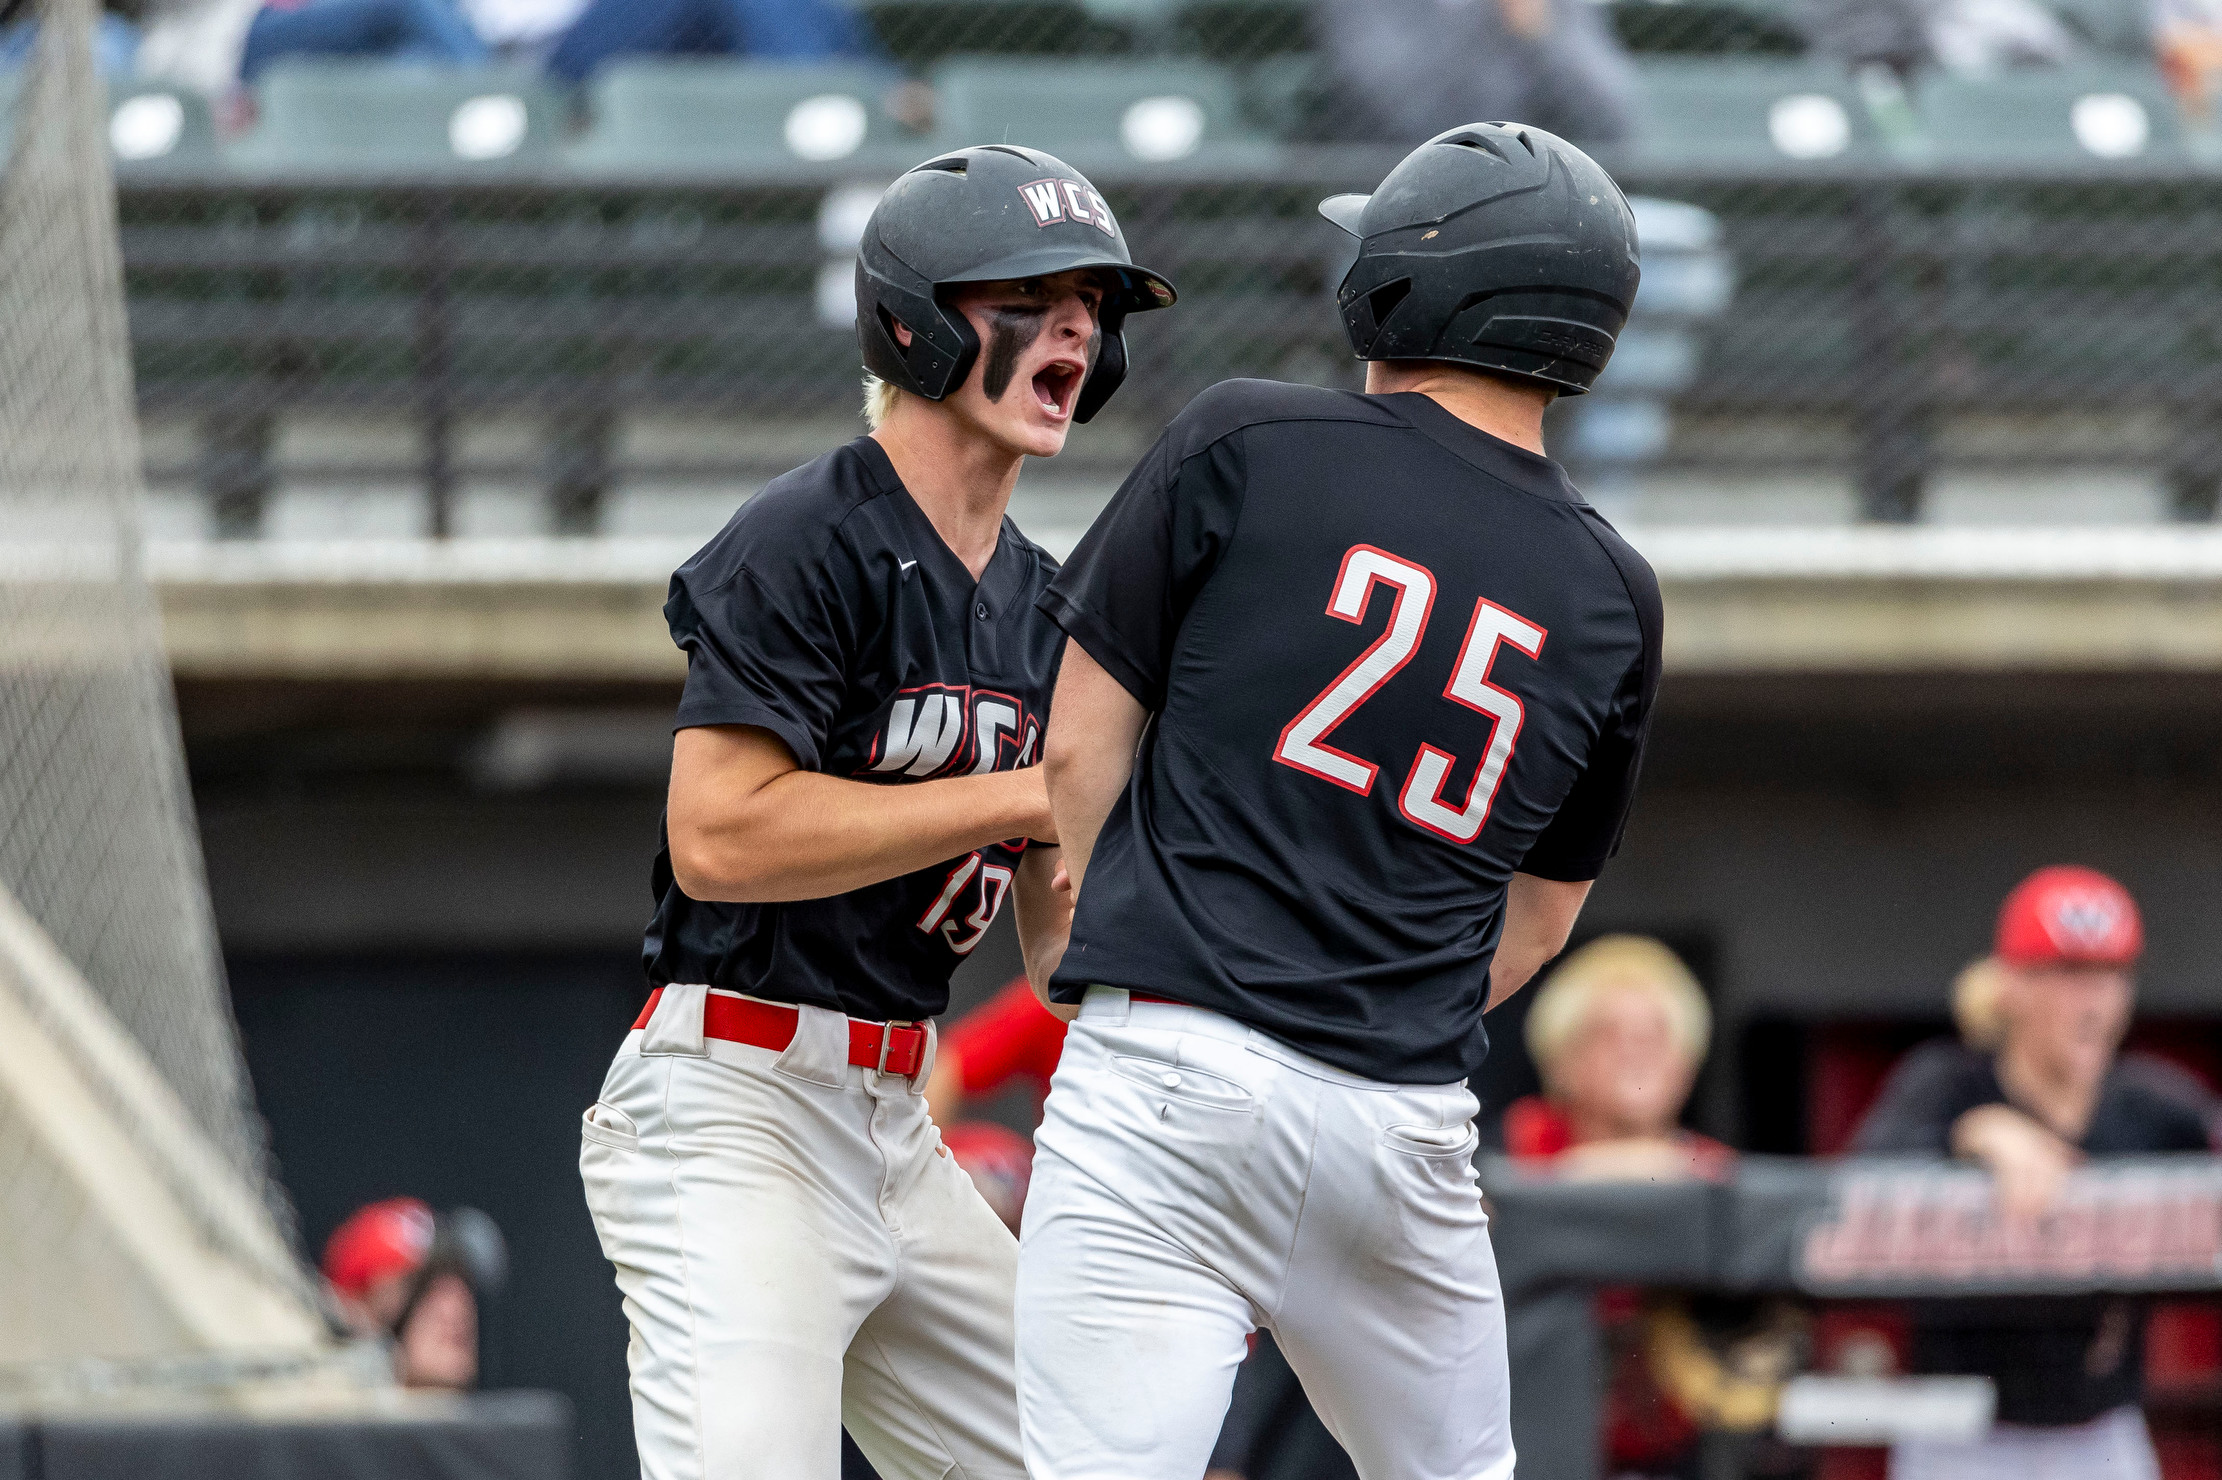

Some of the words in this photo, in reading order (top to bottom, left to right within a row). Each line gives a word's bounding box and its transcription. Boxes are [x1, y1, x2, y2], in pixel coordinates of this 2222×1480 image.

[1018, 178, 1115, 238] WCS
[1272, 543, 1548, 844] 25
[916, 851, 1014, 955] 19
